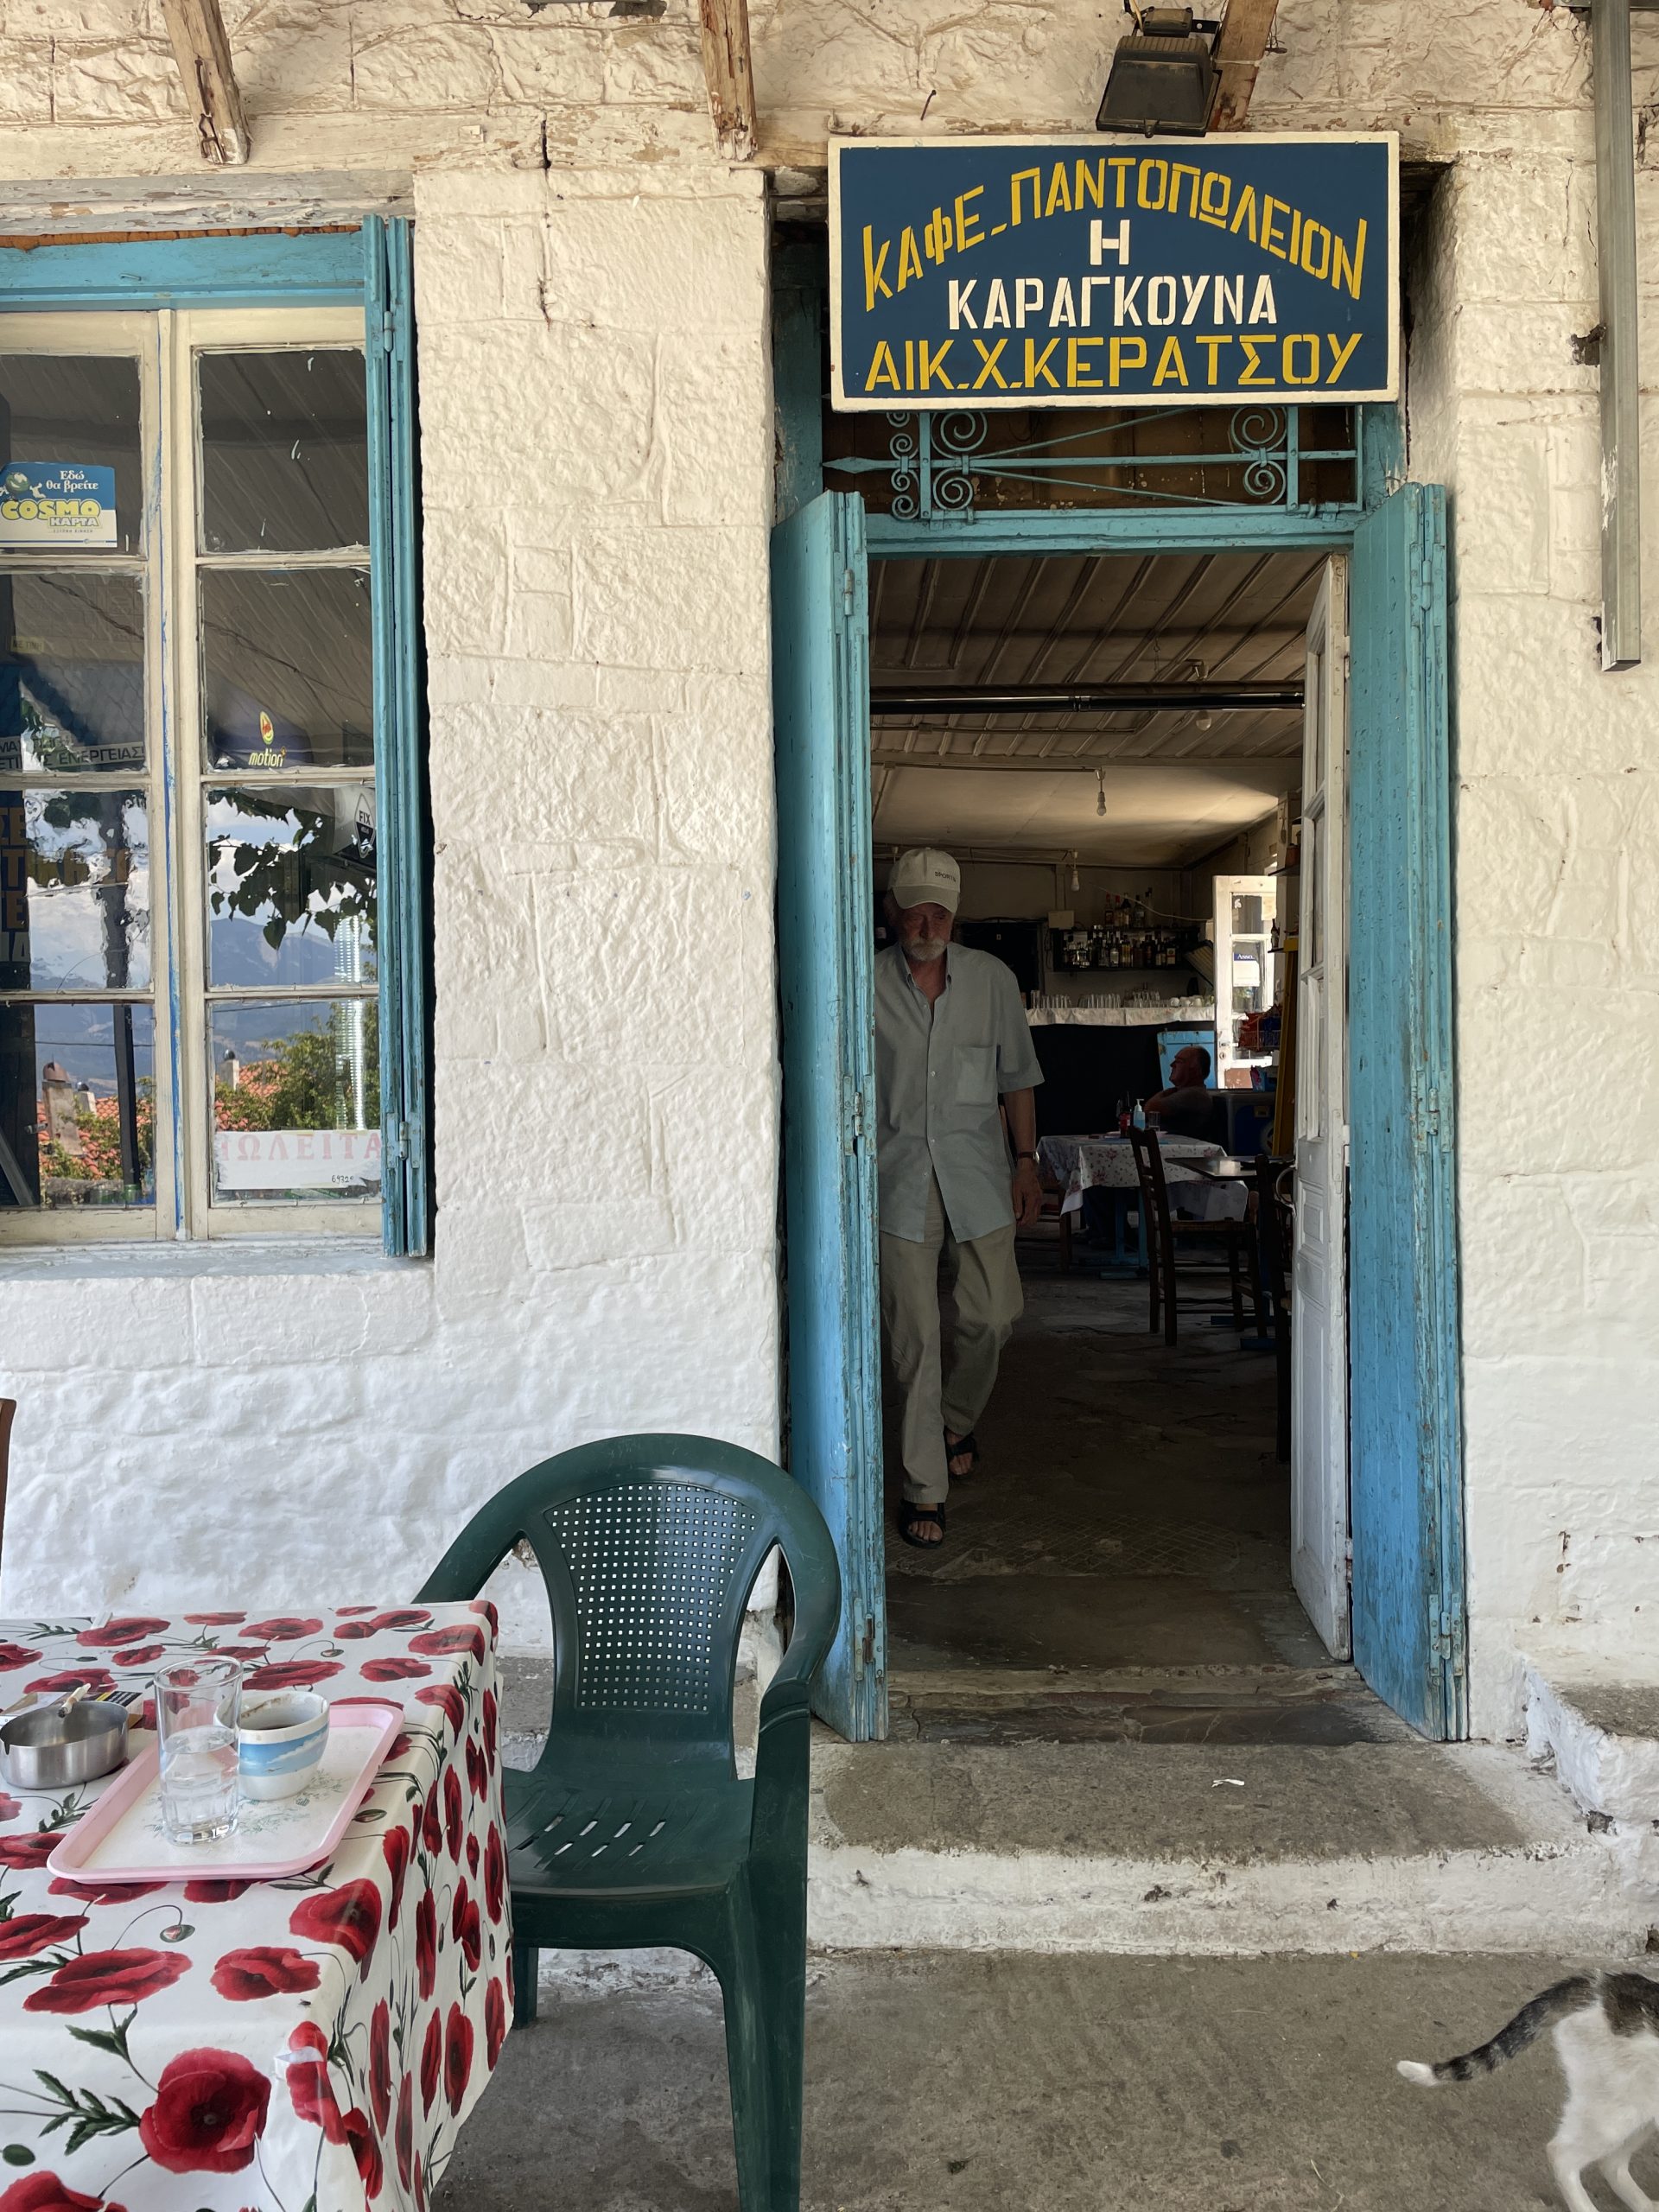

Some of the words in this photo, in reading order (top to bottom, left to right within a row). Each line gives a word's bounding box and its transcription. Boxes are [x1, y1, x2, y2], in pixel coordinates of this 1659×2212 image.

[1090, 219, 1130, 265] Η
[949, 275, 1277, 329] ΚΑΡΑΓΚΟΥΝΑ
[60, 469, 85, 480] Εδώ
[46, 480, 60, 489] θα
[63, 480, 99, 493] βρείτε
[1, 499, 101, 520] COSMO
[49, 517, 99, 527] ΚΑΡΤΑ
[248, 748, 283, 767] motion
[359, 810, 371, 826] FIX
[219, 1133, 381, 1161] ΩΛΕΙΤΑ
